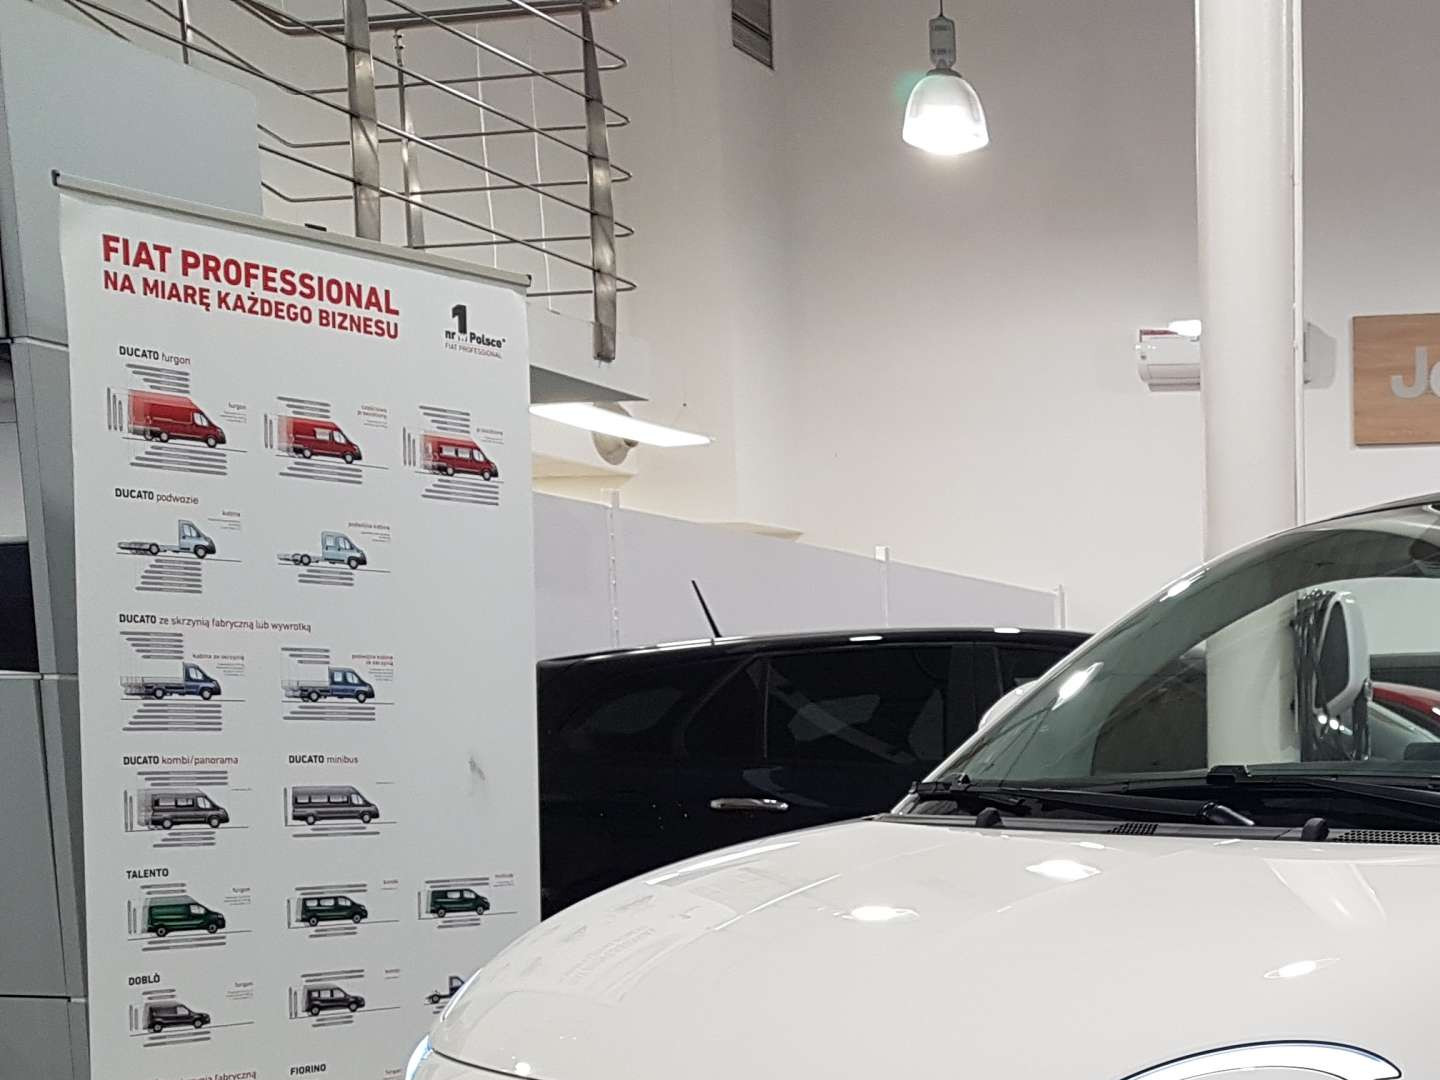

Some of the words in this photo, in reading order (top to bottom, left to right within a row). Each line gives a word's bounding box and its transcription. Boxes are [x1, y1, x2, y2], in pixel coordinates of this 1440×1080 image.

[102, 233, 172, 273] FIAT
[181, 249, 400, 316] PROFESSIONAL
[103, 269, 136, 294] NA
[142, 276, 210, 312] MIARĘ
[217, 290, 313, 325] KAŻDEGO
[318, 307, 399, 340] BIZNESU
[445, 329, 456, 340] nr
[452, 304, 467, 335] 1
[119, 345, 159, 361] DUCATO
[161, 352, 191, 366] furgon
[115, 488, 154, 501] DUCATO
[156, 493, 199, 505] podwozie
[119, 614, 157, 625] DUCATO
[159, 616, 169, 625] ze
[171, 616, 210, 629] skrzynią
[212, 618, 254, 631] fabryczną
[256, 620, 270, 630] lub
[270, 621, 312, 633] wywrotką
[123, 755, 160, 766] DUCATO
[161, 755, 239, 767] kombi/panorama
[288, 754, 325, 764] DUCATO
[326, 754, 359, 765] minibus
[126, 868, 169, 880] TALENTO
[128, 973, 161, 986] DOBLÒ
[290, 1063, 327, 1076] FIORINO
